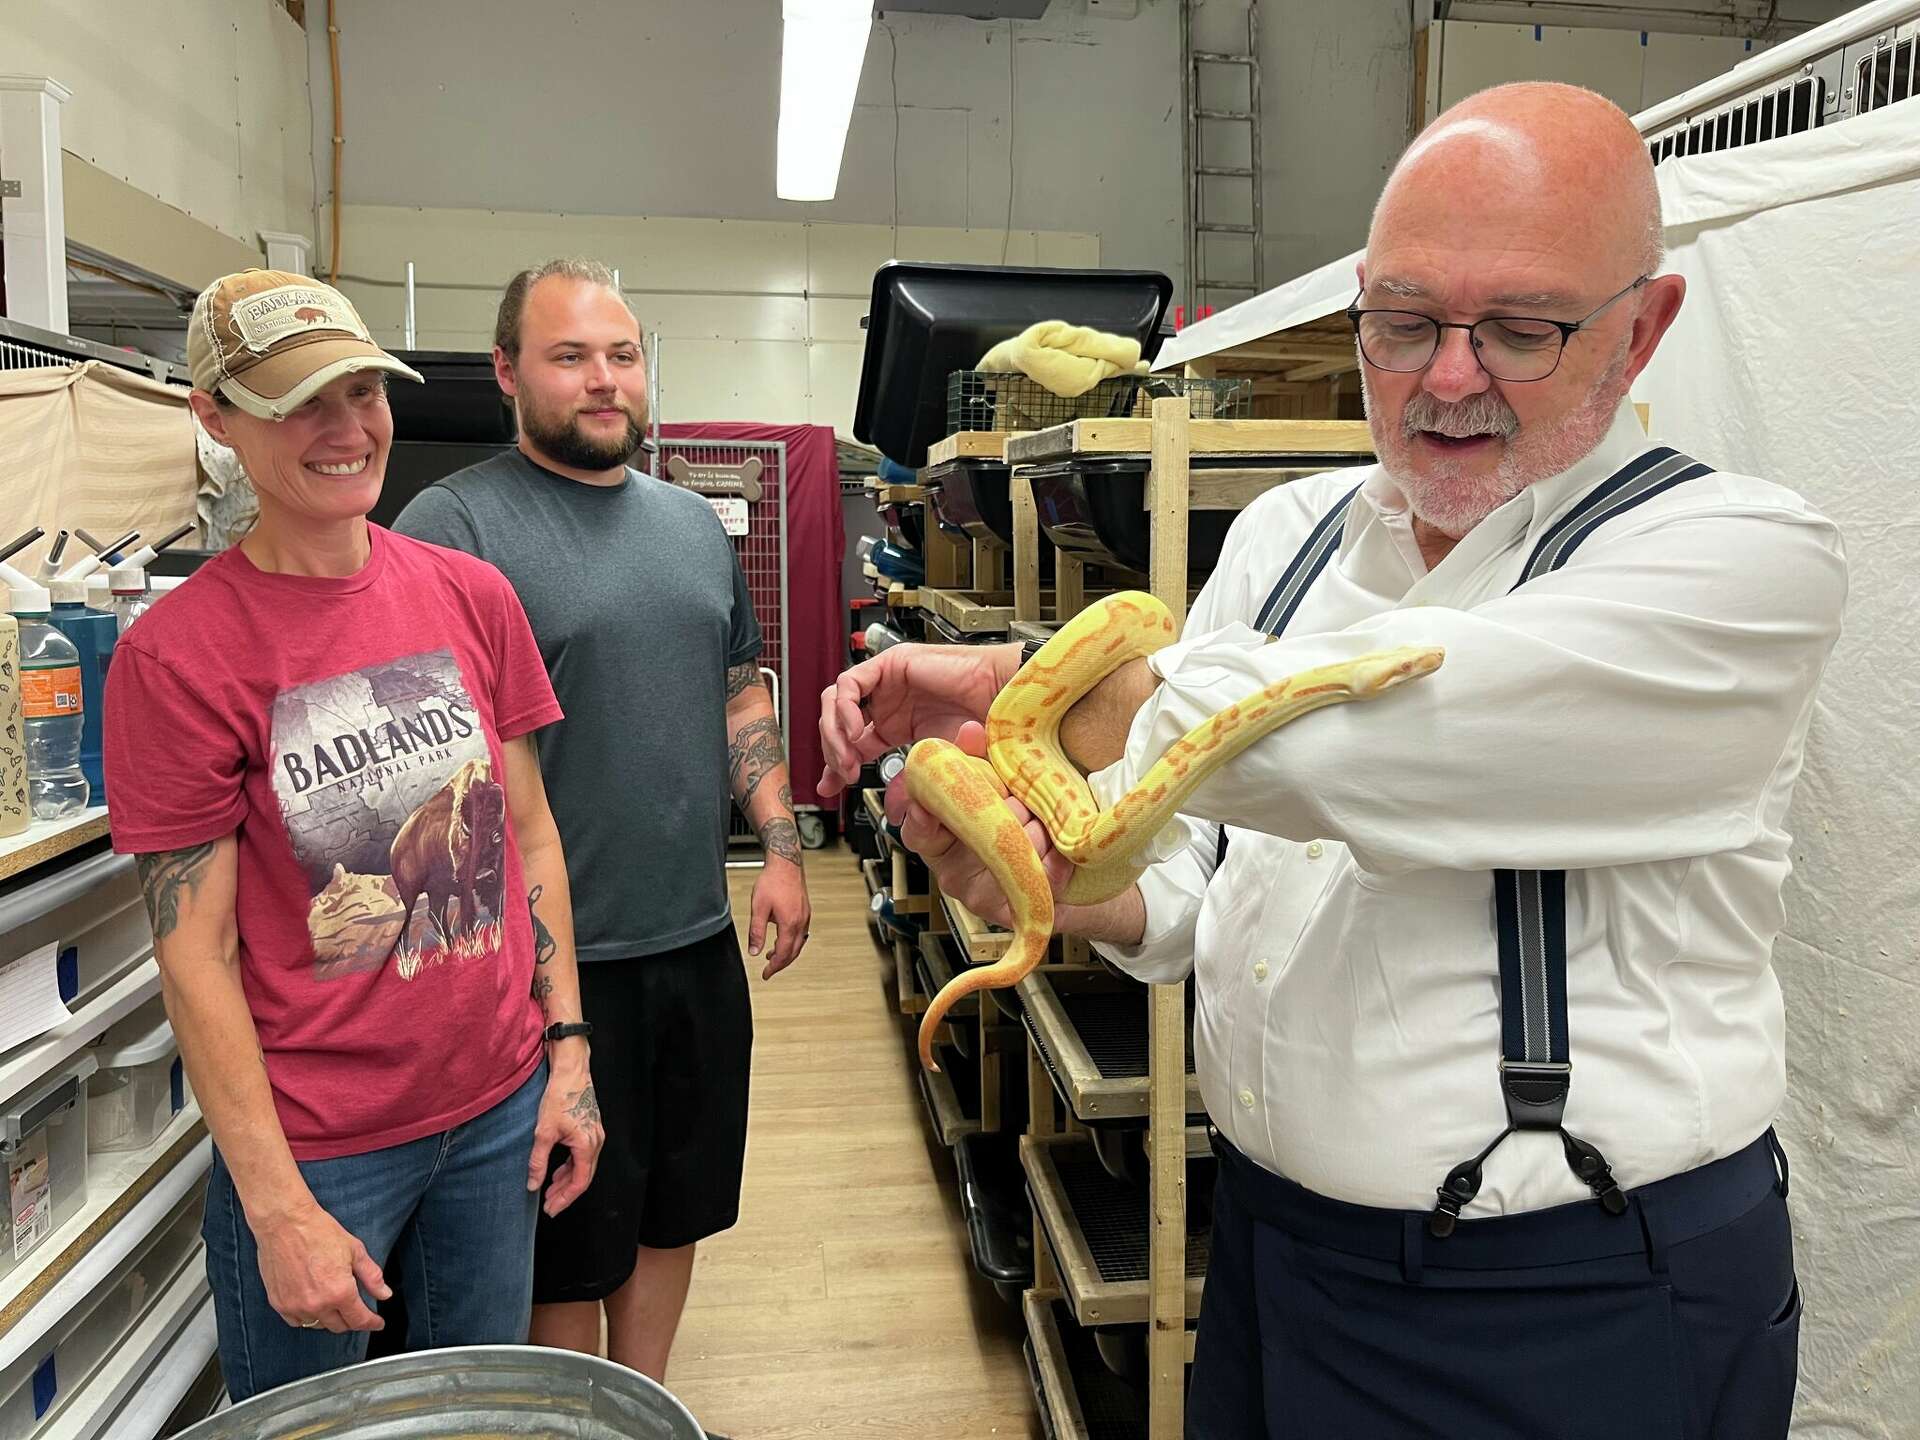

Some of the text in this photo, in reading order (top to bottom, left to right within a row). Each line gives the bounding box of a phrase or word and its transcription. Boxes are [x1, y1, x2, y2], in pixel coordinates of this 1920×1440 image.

[282, 702, 473, 794] BADLANDS
[336, 748, 453, 794] NATIONAL PARK
